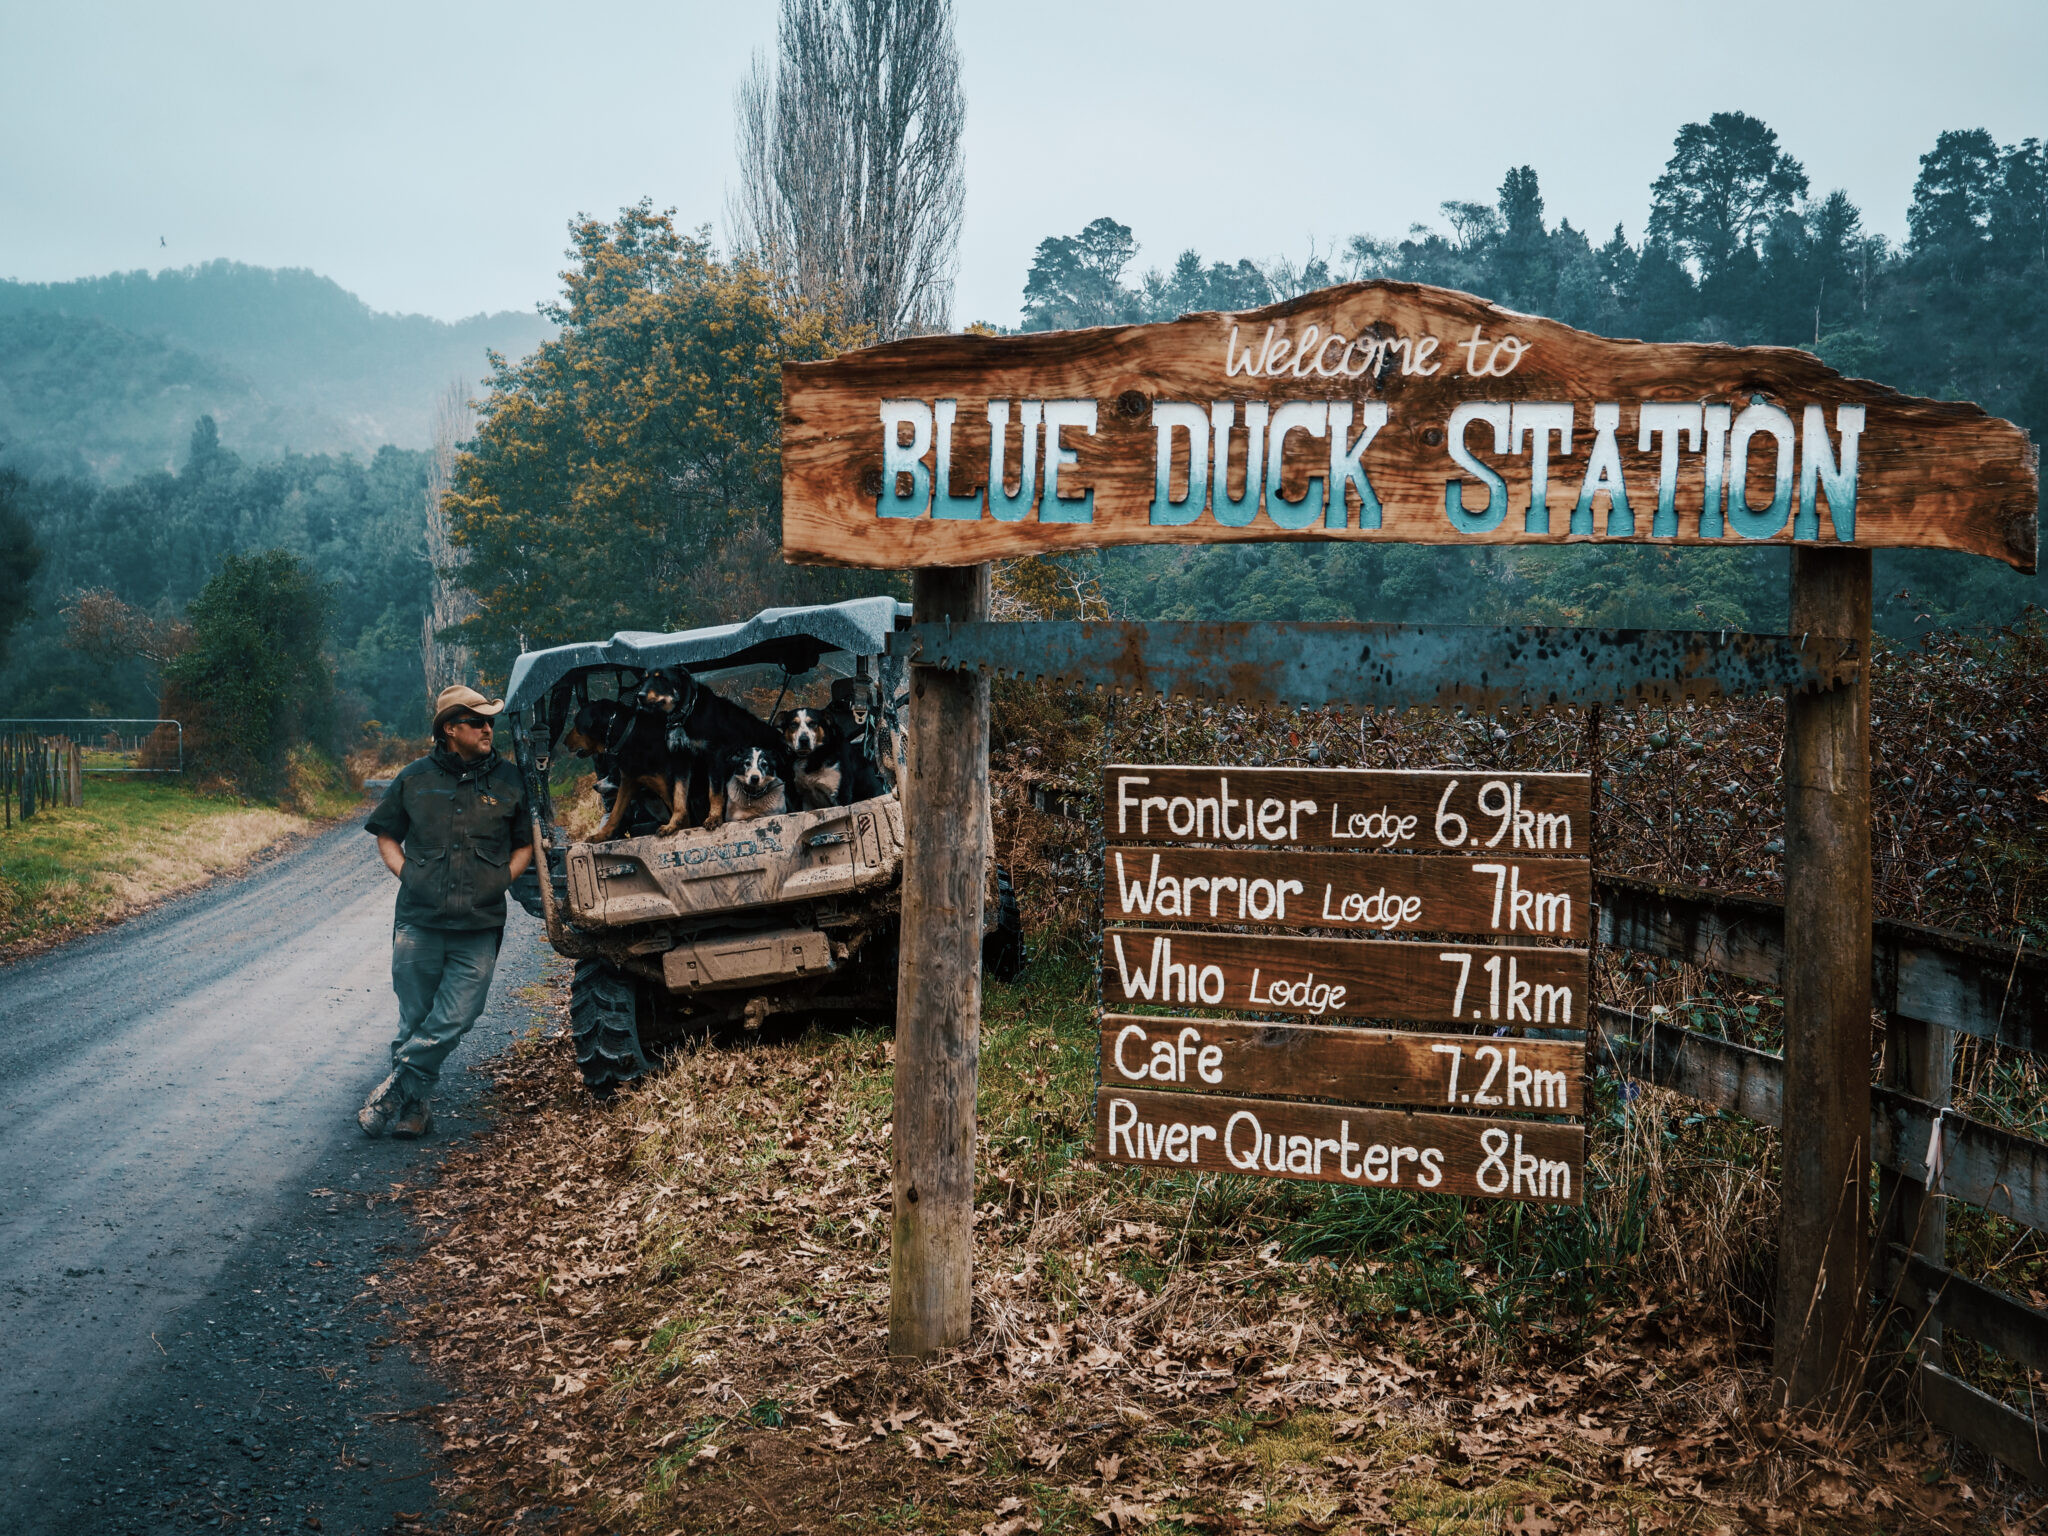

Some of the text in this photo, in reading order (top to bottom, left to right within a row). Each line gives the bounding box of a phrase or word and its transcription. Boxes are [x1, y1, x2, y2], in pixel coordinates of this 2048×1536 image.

[1225, 323, 1533, 378] Welcome to
[876, 398, 1866, 543] BLUE DUCK STATION
[1117, 776, 1318, 841] Frontier
[1331, 803, 1418, 848] Lodge
[659, 837, 784, 869] HONDA
[1115, 852, 1304, 920] Warrior
[1322, 884, 1423, 931] Lodge
[1112, 935, 1225, 1005] Whio
[1248, 968, 1348, 1015] Lodge
[1114, 1024, 1224, 1084] Cafe
[1108, 1098, 1217, 1164] River
[1224, 1110, 1445, 1188] Quarters
